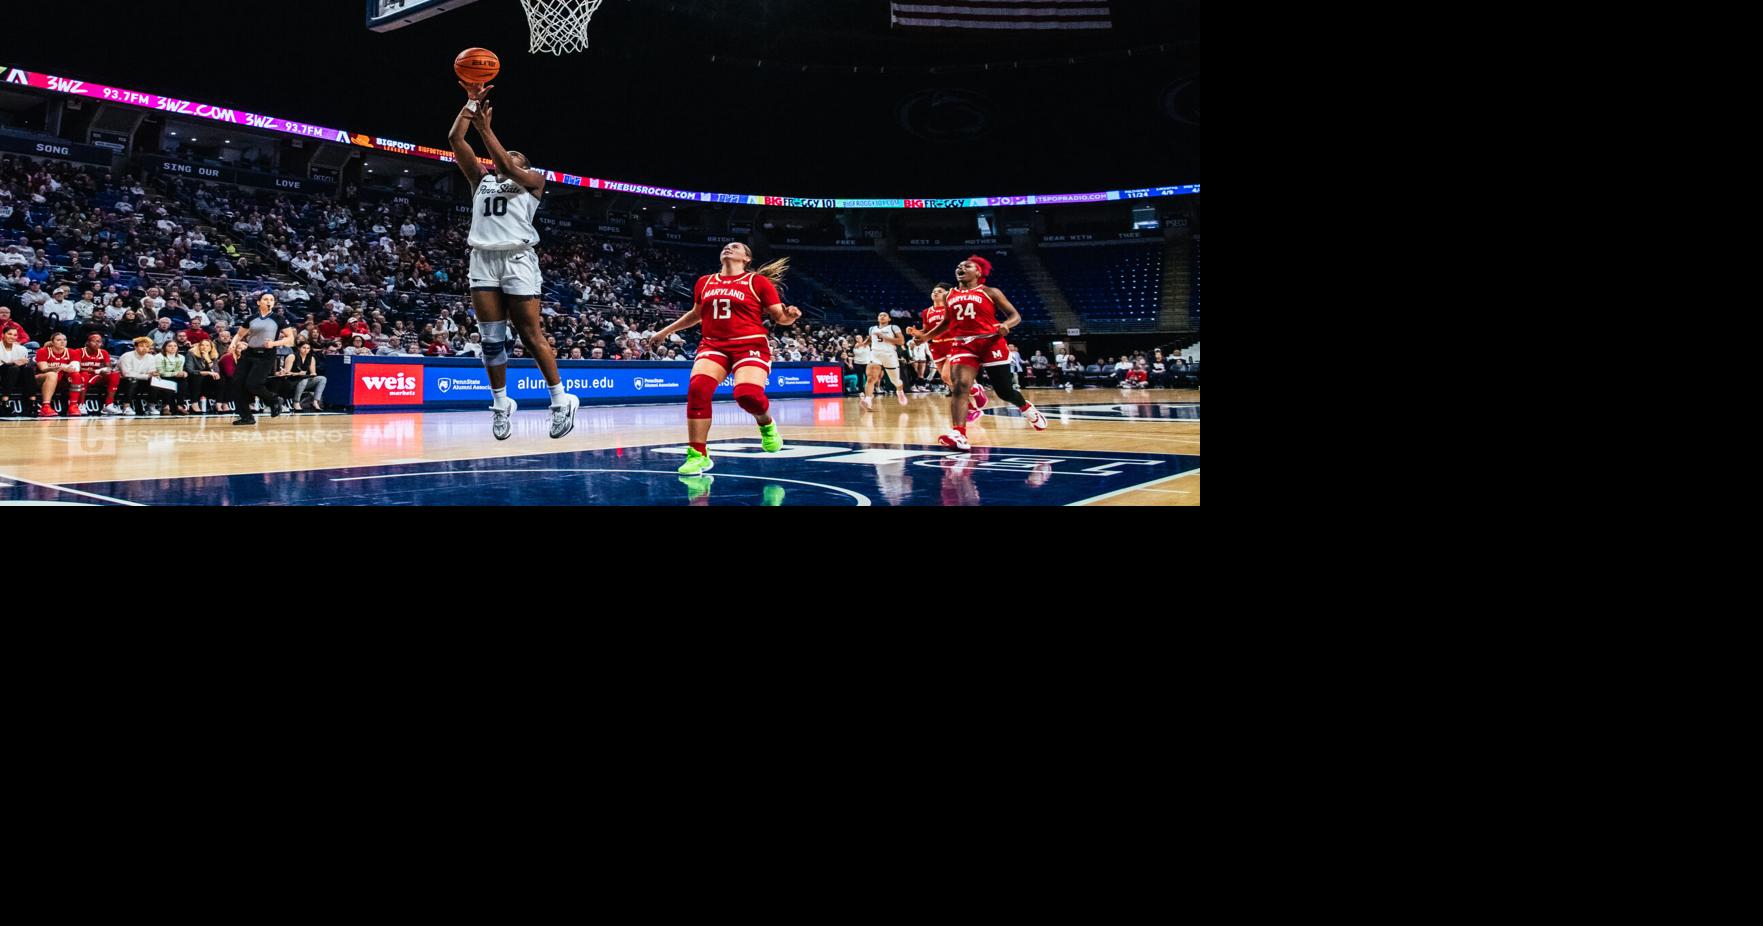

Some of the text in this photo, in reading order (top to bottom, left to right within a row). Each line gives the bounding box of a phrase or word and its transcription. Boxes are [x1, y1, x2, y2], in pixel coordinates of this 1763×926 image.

[47, 75, 323, 137] 3WZ 93.7FM 3WZ.COM 3WZ 93.7FM
[36, 143, 70, 156] SONG
[376, 137, 416, 152] BIGFOOT
[163, 162, 220, 178] SING OUR
[276, 179, 301, 190] LOVE
[604, 181, 696, 200] THEBUSROCKS.COM
[483, 196, 508, 217] 10
[765, 196, 783, 206] BIG
[904, 199, 924, 208] BIG
[703, 288, 745, 301] MARYLAND
[712, 299, 732, 320] 13
[953, 303, 977, 321] 24
[749, 350, 761, 358] M
[991, 349, 1003, 359] M
[361, 371, 416, 391] weis
[815, 372, 839, 384] weis
